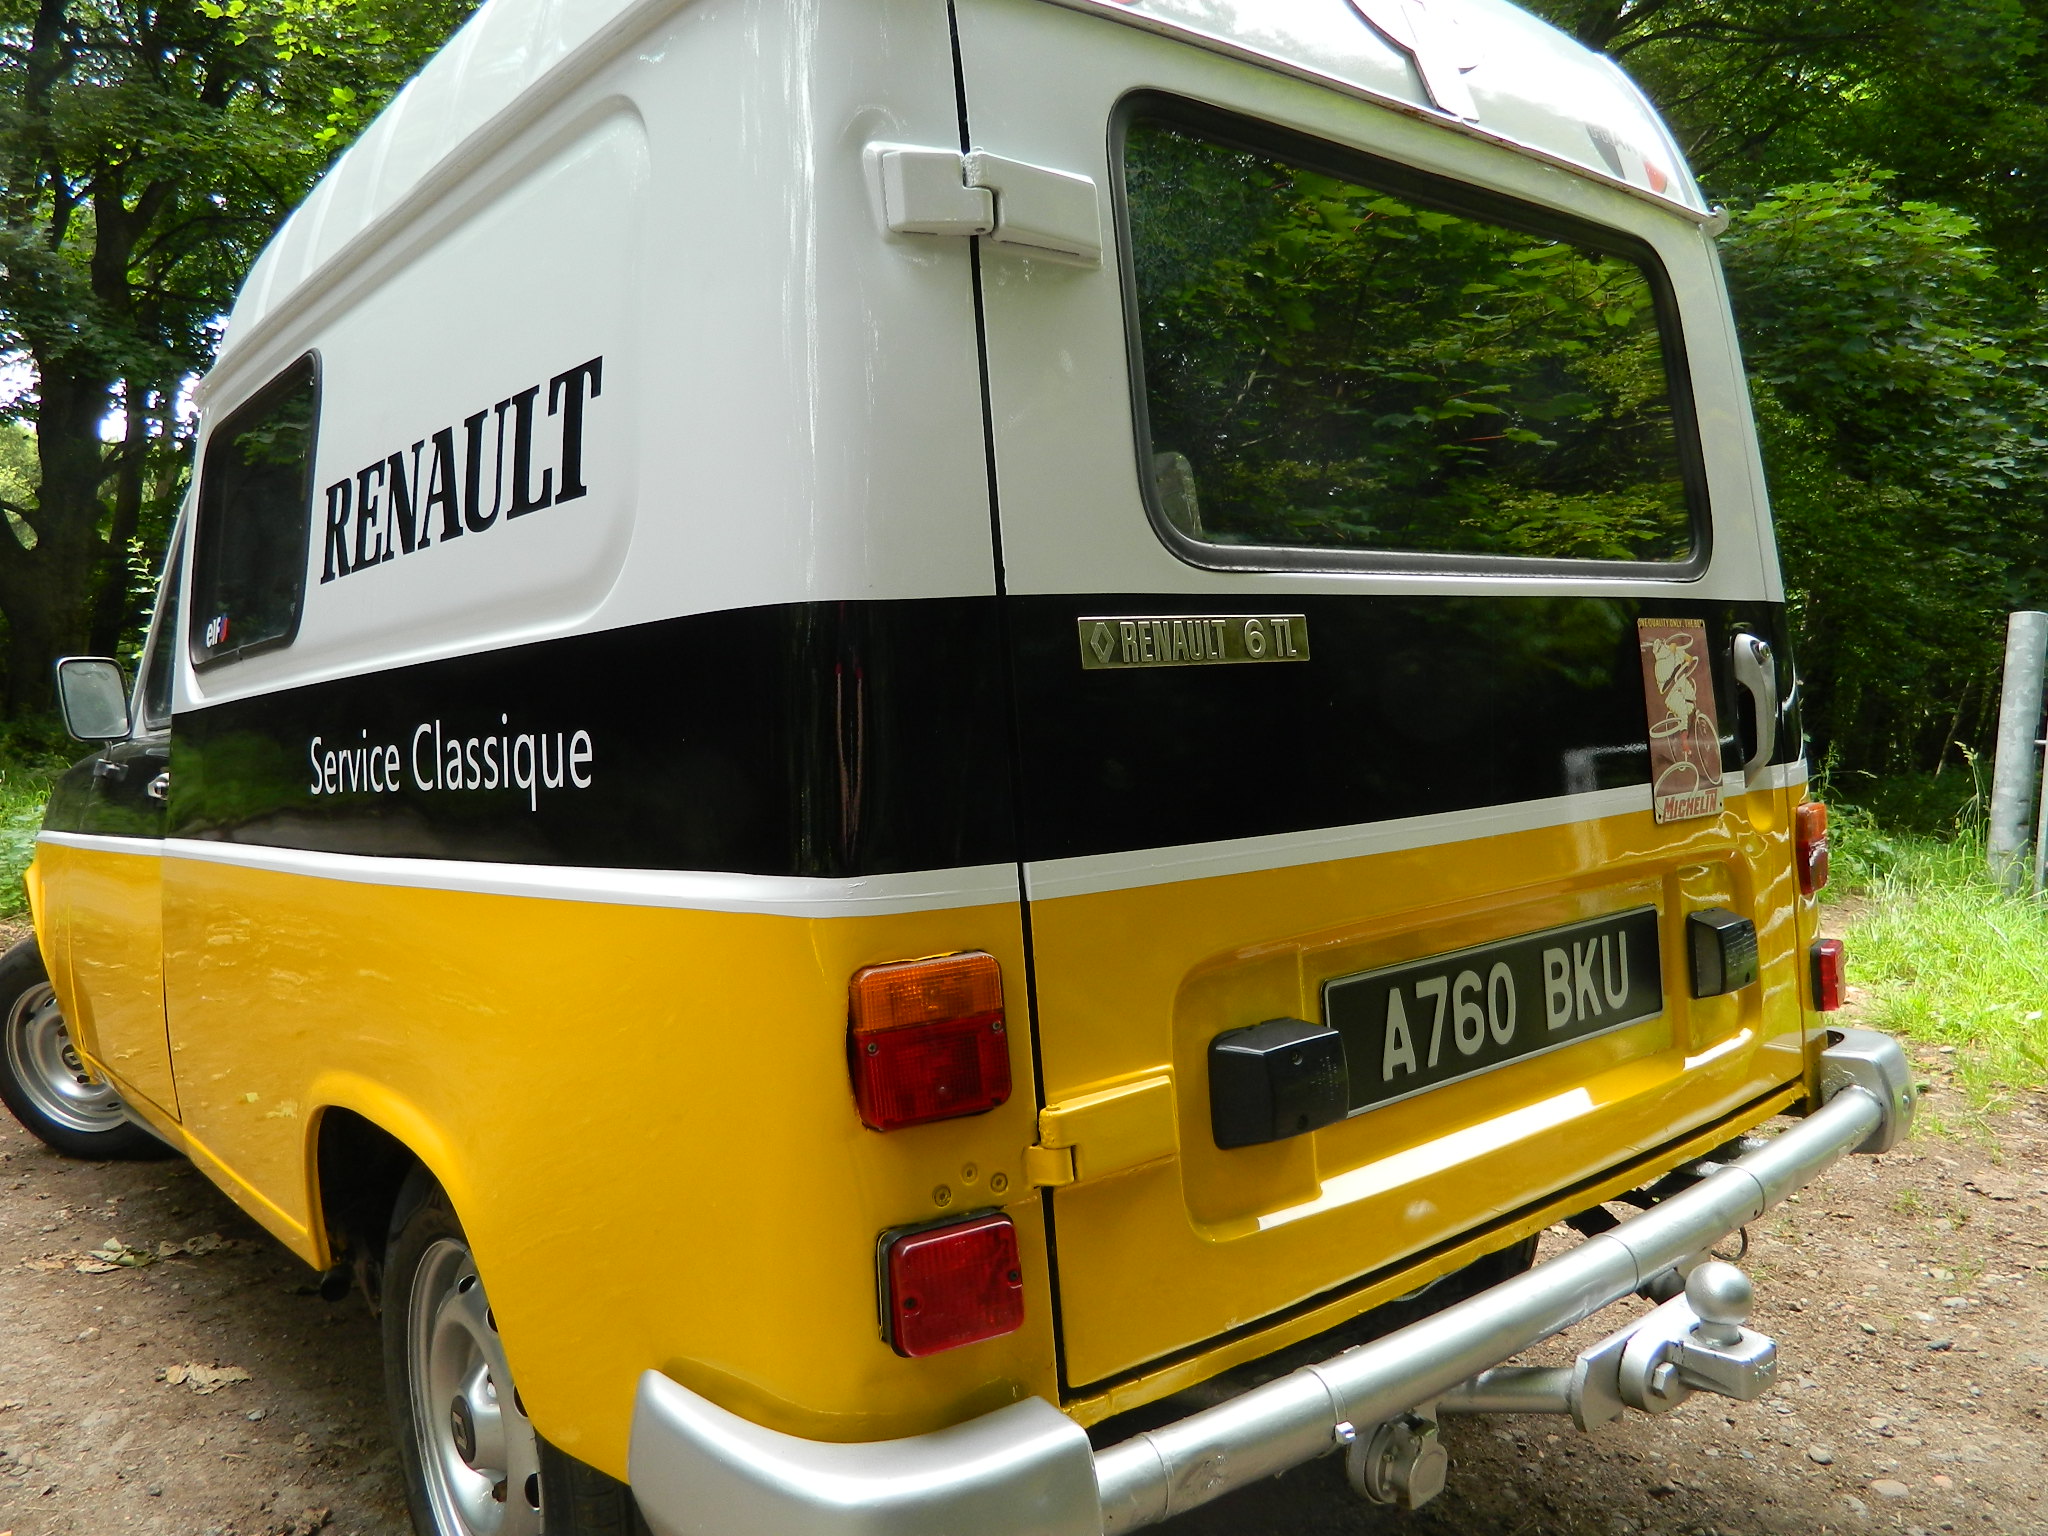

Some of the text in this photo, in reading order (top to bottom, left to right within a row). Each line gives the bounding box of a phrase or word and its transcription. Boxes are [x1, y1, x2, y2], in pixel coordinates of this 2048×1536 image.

[320, 355, 603, 585] RENAULT
[1119, 619, 1297, 663] RENAULT 6 TL
[310, 713, 593, 812] Service Classique
[1663, 788, 1718, 822] MICHELIN
[1382, 962, 1517, 1082] A760
[1543, 930, 1630, 1031] BKU
